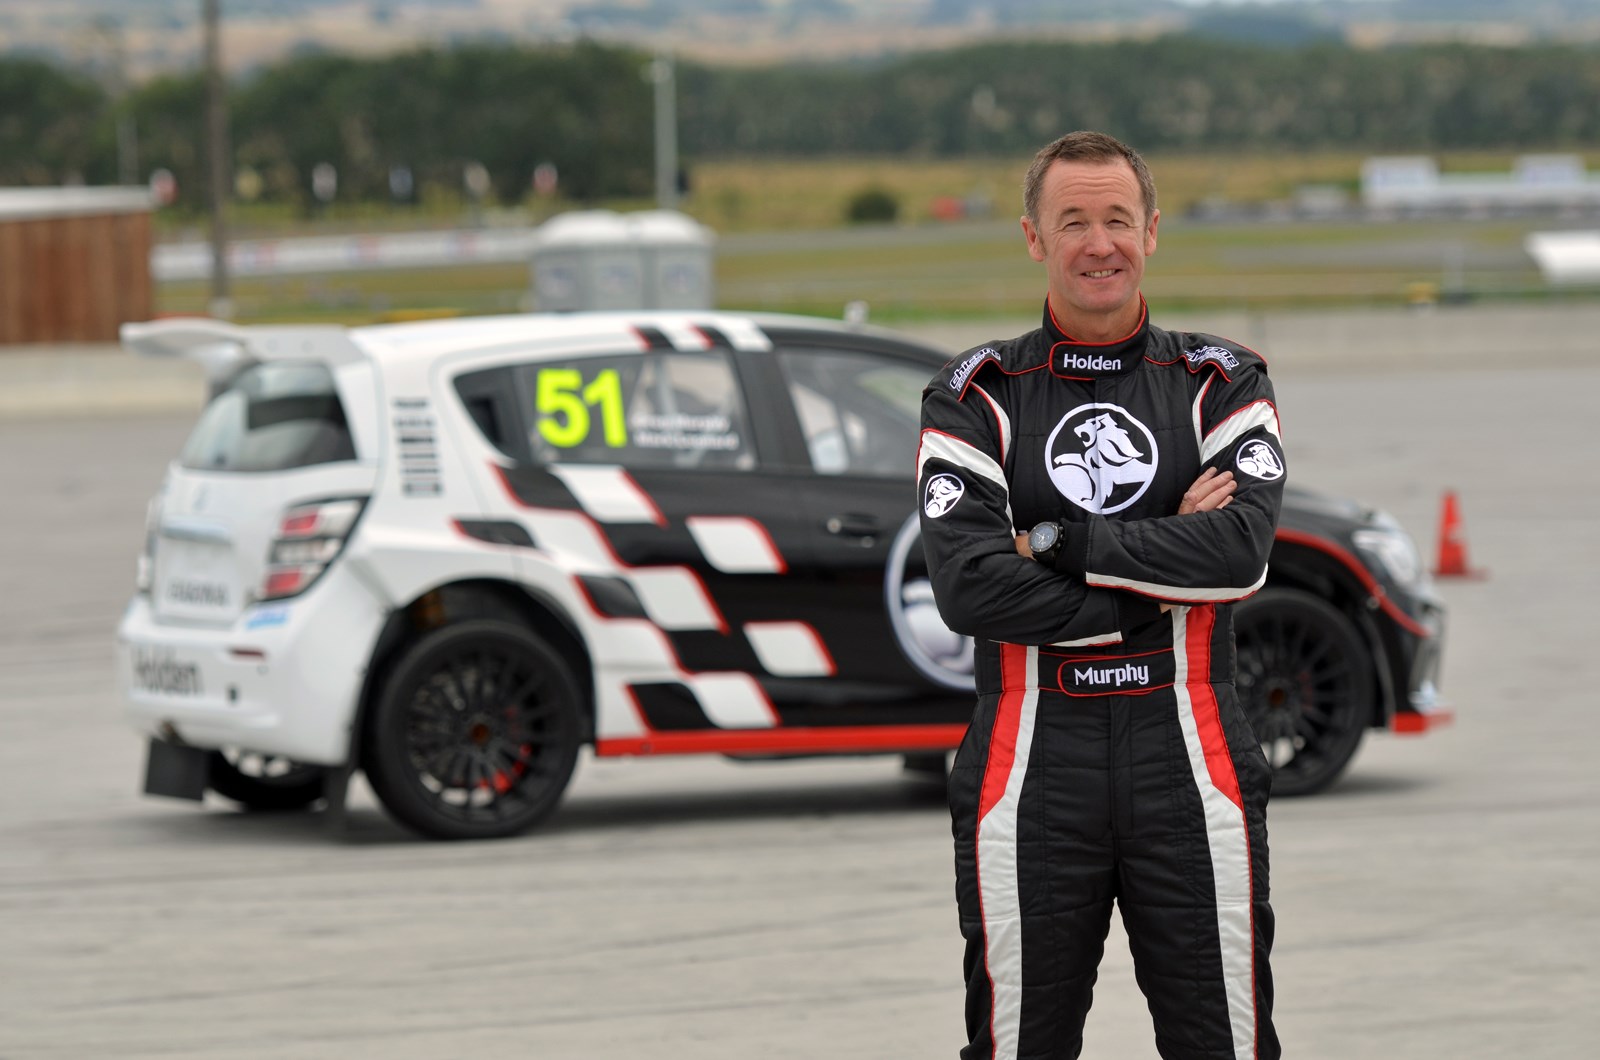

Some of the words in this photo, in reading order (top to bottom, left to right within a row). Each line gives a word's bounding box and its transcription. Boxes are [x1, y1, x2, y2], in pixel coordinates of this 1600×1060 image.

[1063, 353, 1121, 371] Holden
[536, 367, 627, 448] 51
[1074, 663, 1149, 687] Murphy
